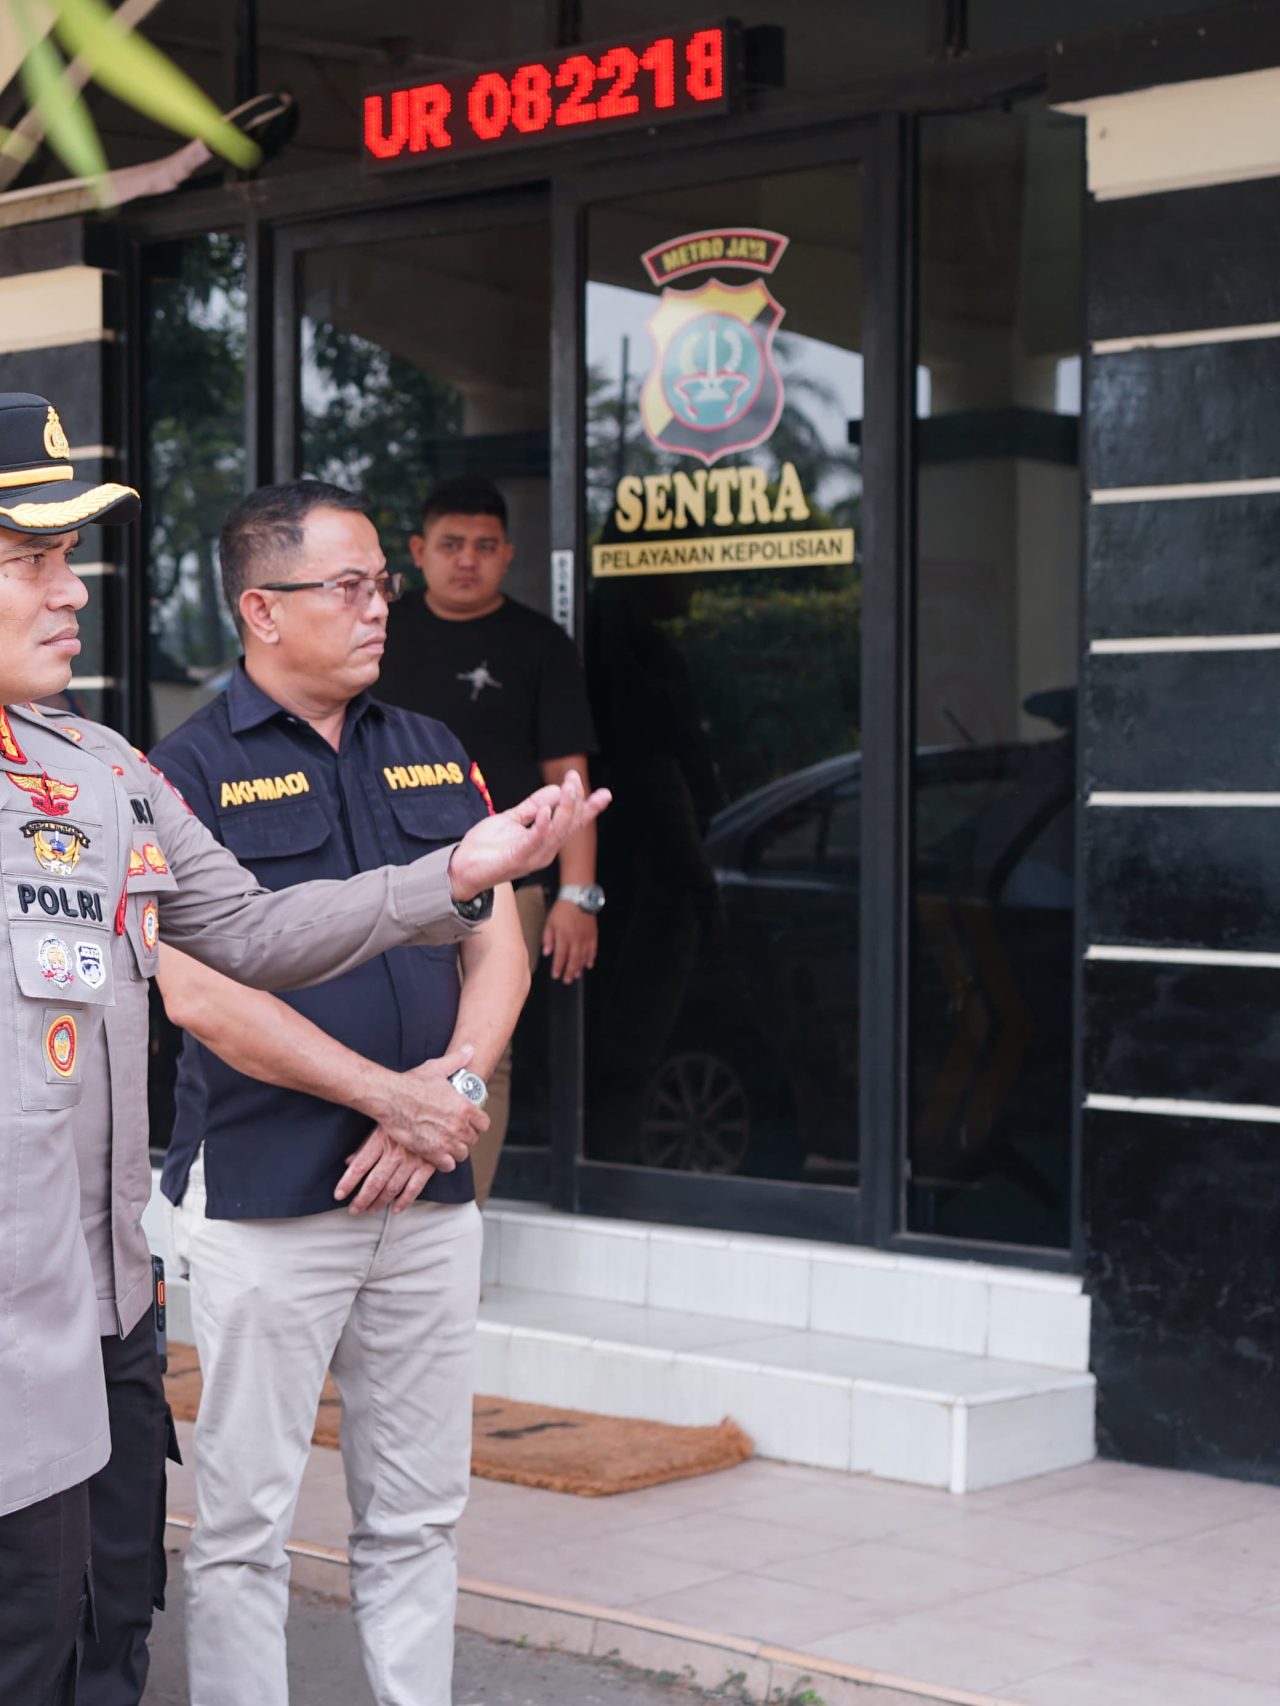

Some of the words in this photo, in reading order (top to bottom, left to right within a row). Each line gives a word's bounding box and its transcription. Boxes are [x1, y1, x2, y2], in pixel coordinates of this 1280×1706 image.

[365, 84, 451, 158] UR
[661, 237, 724, 273] METRO
[726, 238, 767, 262] JAYA
[616, 461, 810, 533] SENTRA
[600, 544, 714, 569] PELAYANAN
[721, 537, 842, 564] KEPOLISIAN
[220, 771, 310, 808] AKHMADI
[383, 762, 464, 790] HUMAS
[18, 884, 103, 922] POLRI
